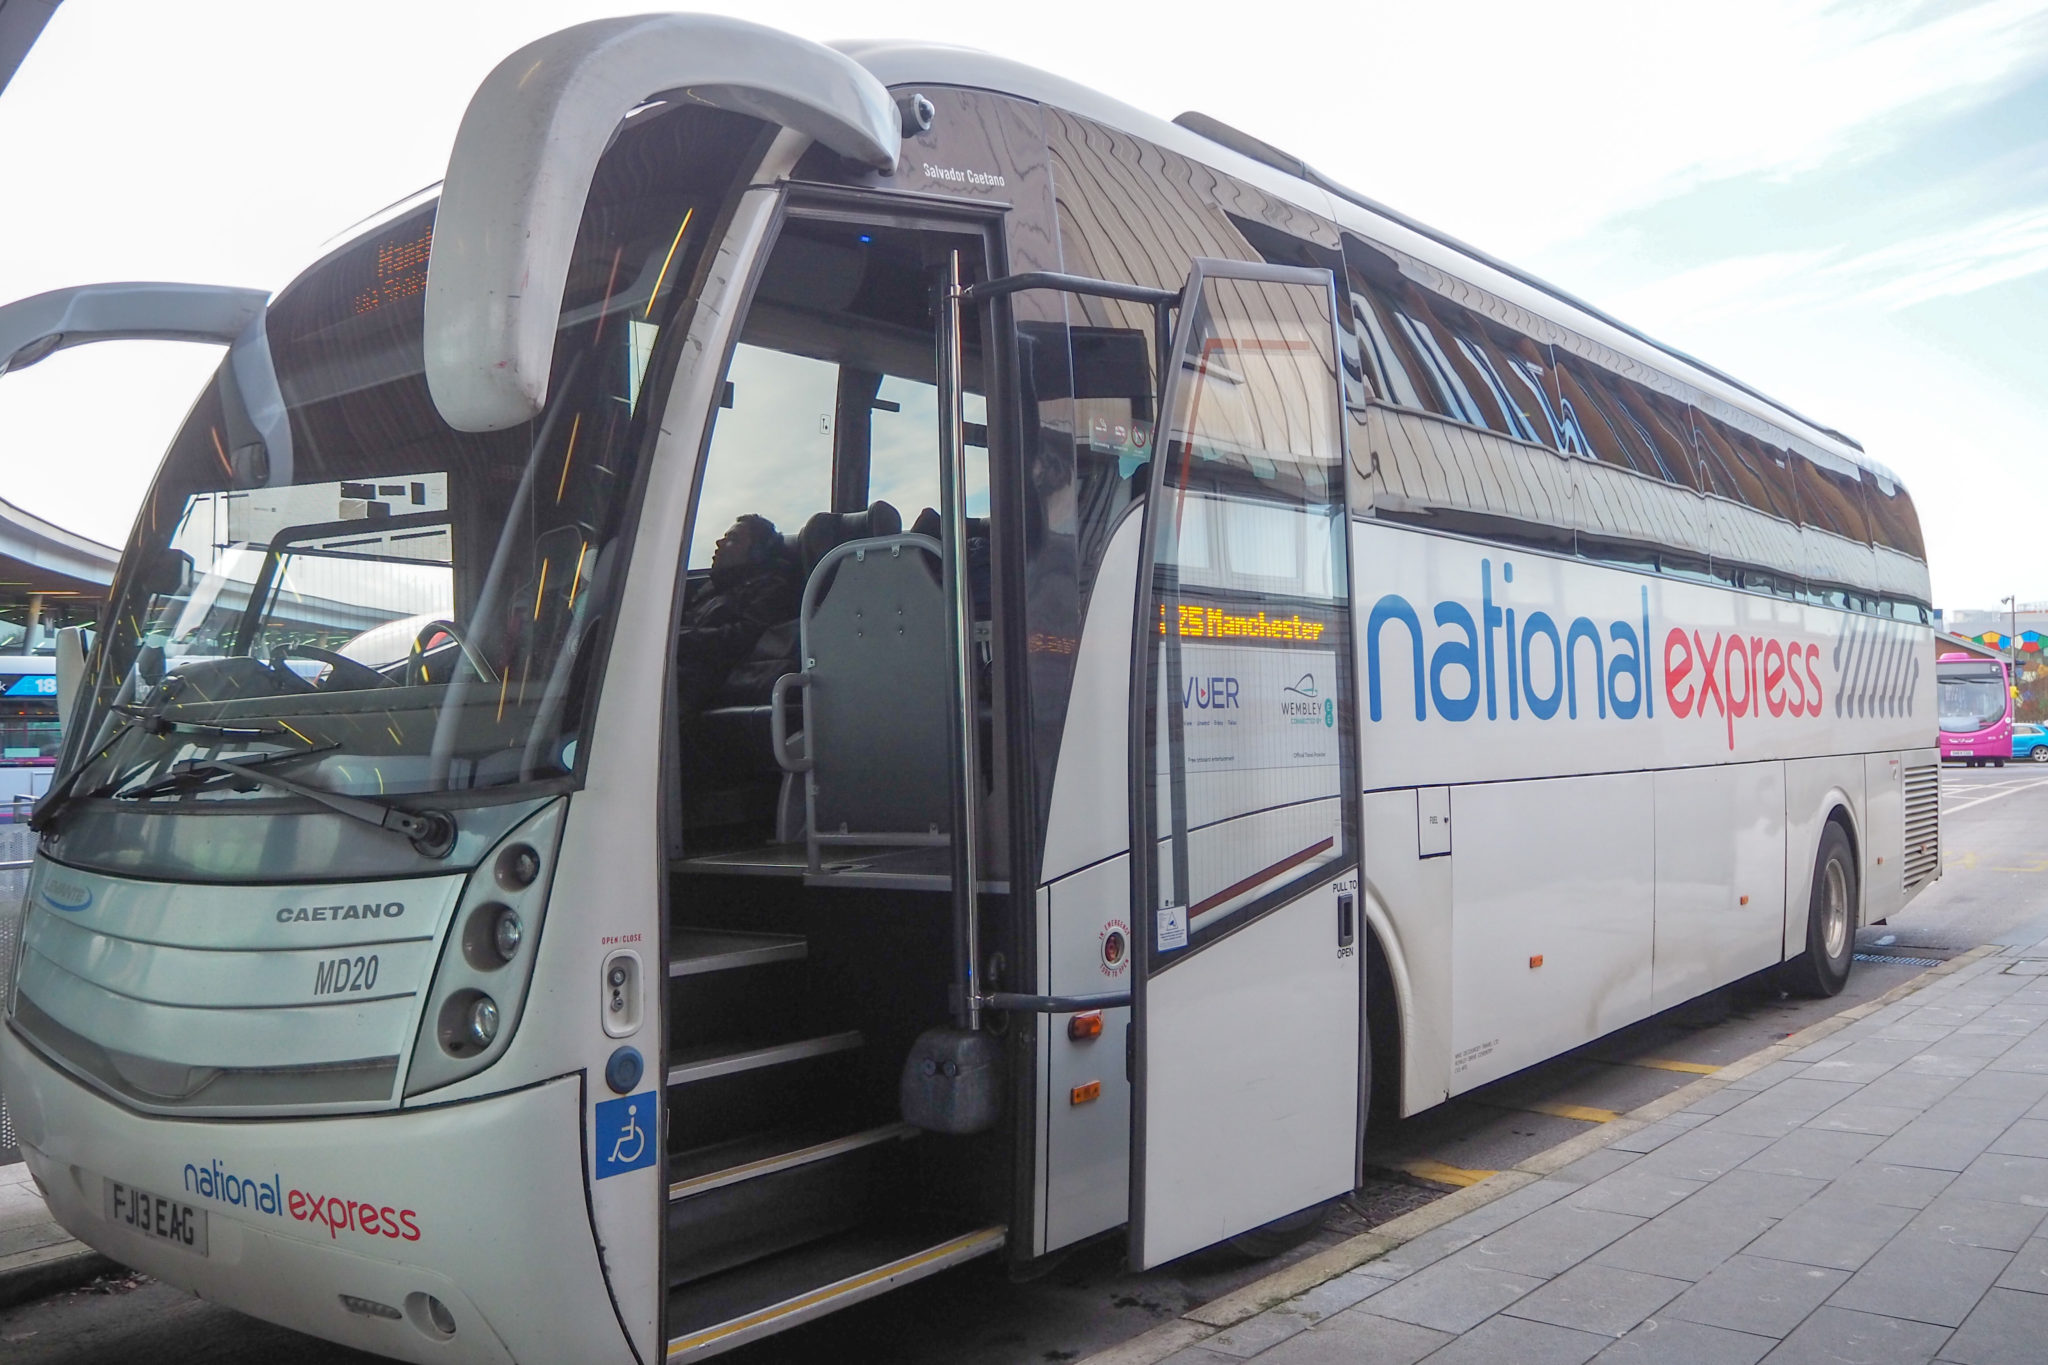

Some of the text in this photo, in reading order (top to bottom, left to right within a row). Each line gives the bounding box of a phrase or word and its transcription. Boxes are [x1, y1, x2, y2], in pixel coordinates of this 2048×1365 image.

[923, 163, 1005, 187] Salvador Caetano
[1207, 608, 1324, 640] Manchester
[1366, 557, 1824, 751] national express
[1182, 676, 1240, 710] VUER
[1281, 702, 1322, 716] WEMBLEY
[1332, 880, 1358, 893] PULL TO
[276, 902, 405, 923] CAETANO
[1336, 947, 1354, 959] OPEN
[313, 954, 379, 996] MD20
[113, 1183, 194, 1246] FJ13 EAG
[184, 1158, 421, 1242] national express
